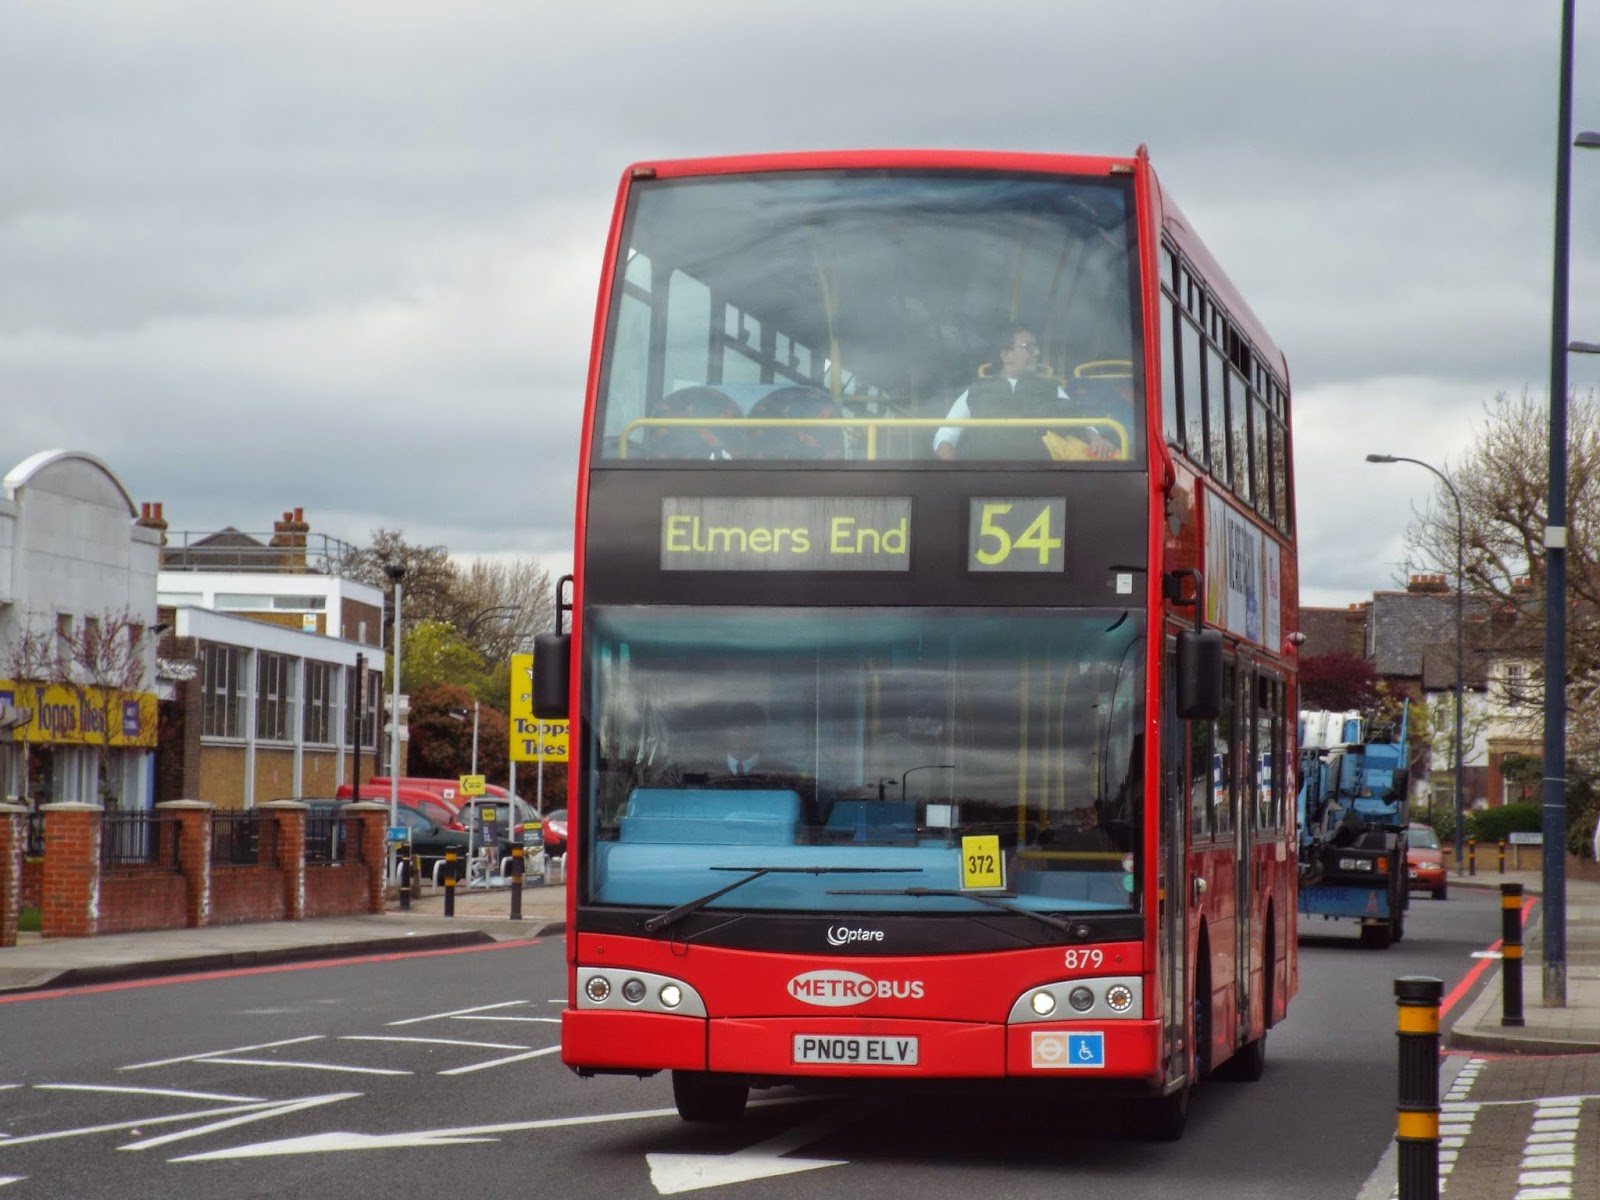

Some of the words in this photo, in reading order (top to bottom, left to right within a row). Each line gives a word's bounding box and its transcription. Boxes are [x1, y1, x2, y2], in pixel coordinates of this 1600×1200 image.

[665, 515, 811, 553] Elmers
[830, 517, 908, 555] End
[975, 503, 1062, 565] 54
[35, 687, 76, 739] Topps
[968, 854, 994, 875] 372
[836, 926, 884, 944] Optare
[1064, 949, 1104, 969] 879
[792, 977, 925, 999] METROBUS
[802, 1038, 860, 1060] PN09
[866, 1040, 909, 1061] ELV
